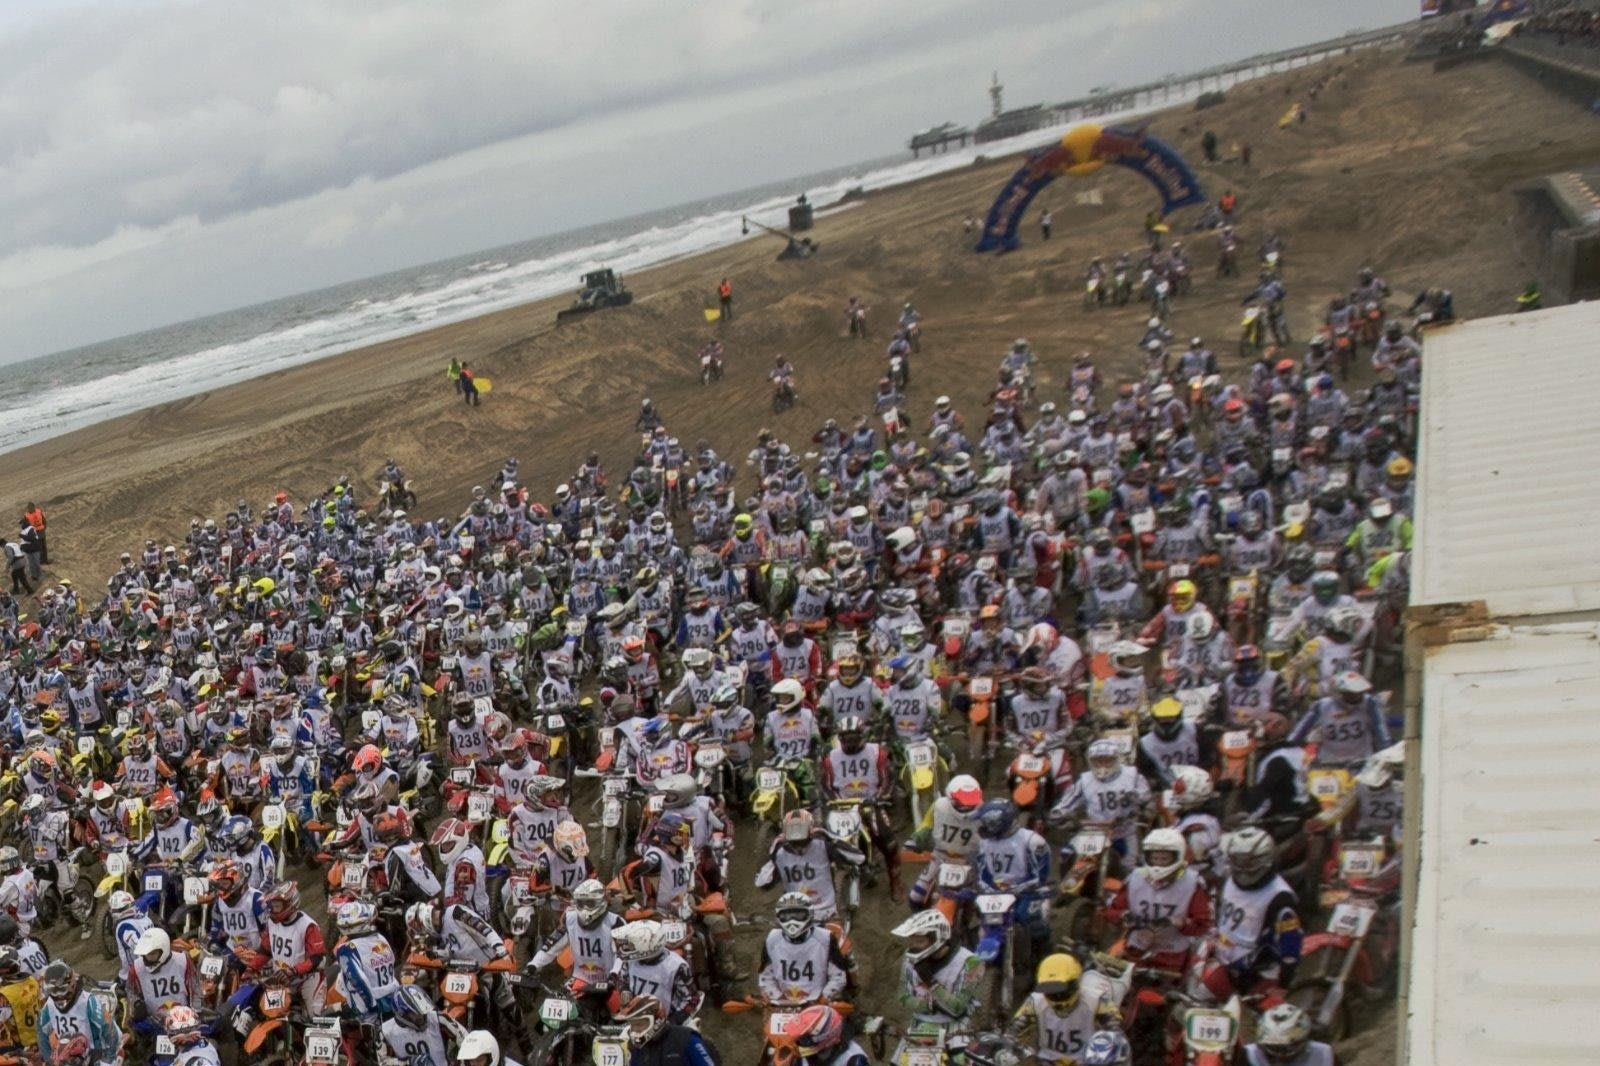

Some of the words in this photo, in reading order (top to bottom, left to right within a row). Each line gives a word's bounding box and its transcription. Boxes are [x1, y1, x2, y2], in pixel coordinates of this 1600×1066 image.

[688, 624, 709, 637] 293
[784, 657, 805, 670] 273
[260, 677, 277, 688] 340
[470, 680, 488, 692] 261
[837, 697, 864, 711] 276
[894, 700, 919, 715] 228
[1022, 710, 1050, 727] 207
[459, 733, 481, 746] 238
[129, 769, 149, 781] 222
[840, 760, 869, 777] 149
[941, 824, 972, 845] 179
[162, 838, 179, 851] 142
[784, 866, 814, 882] 166
[225, 913, 246, 928] 140
[272, 936, 293, 955] 195
[578, 938, 603, 957] 114
[23, 952, 46, 971] 180
[376, 964, 394, 985] 139
[781, 961, 814, 981] 164
[151, 979, 179, 996] 126
[631, 975, 659, 995] 177
[547, 1008, 563, 1018] 114
[55, 1016, 78, 1036] 135
[1048, 1029, 1082, 1052] 165
[159, 1043, 172, 1054] 126
[314, 1045, 329, 1056] 139
[602, 1054, 618, 1066] 177
